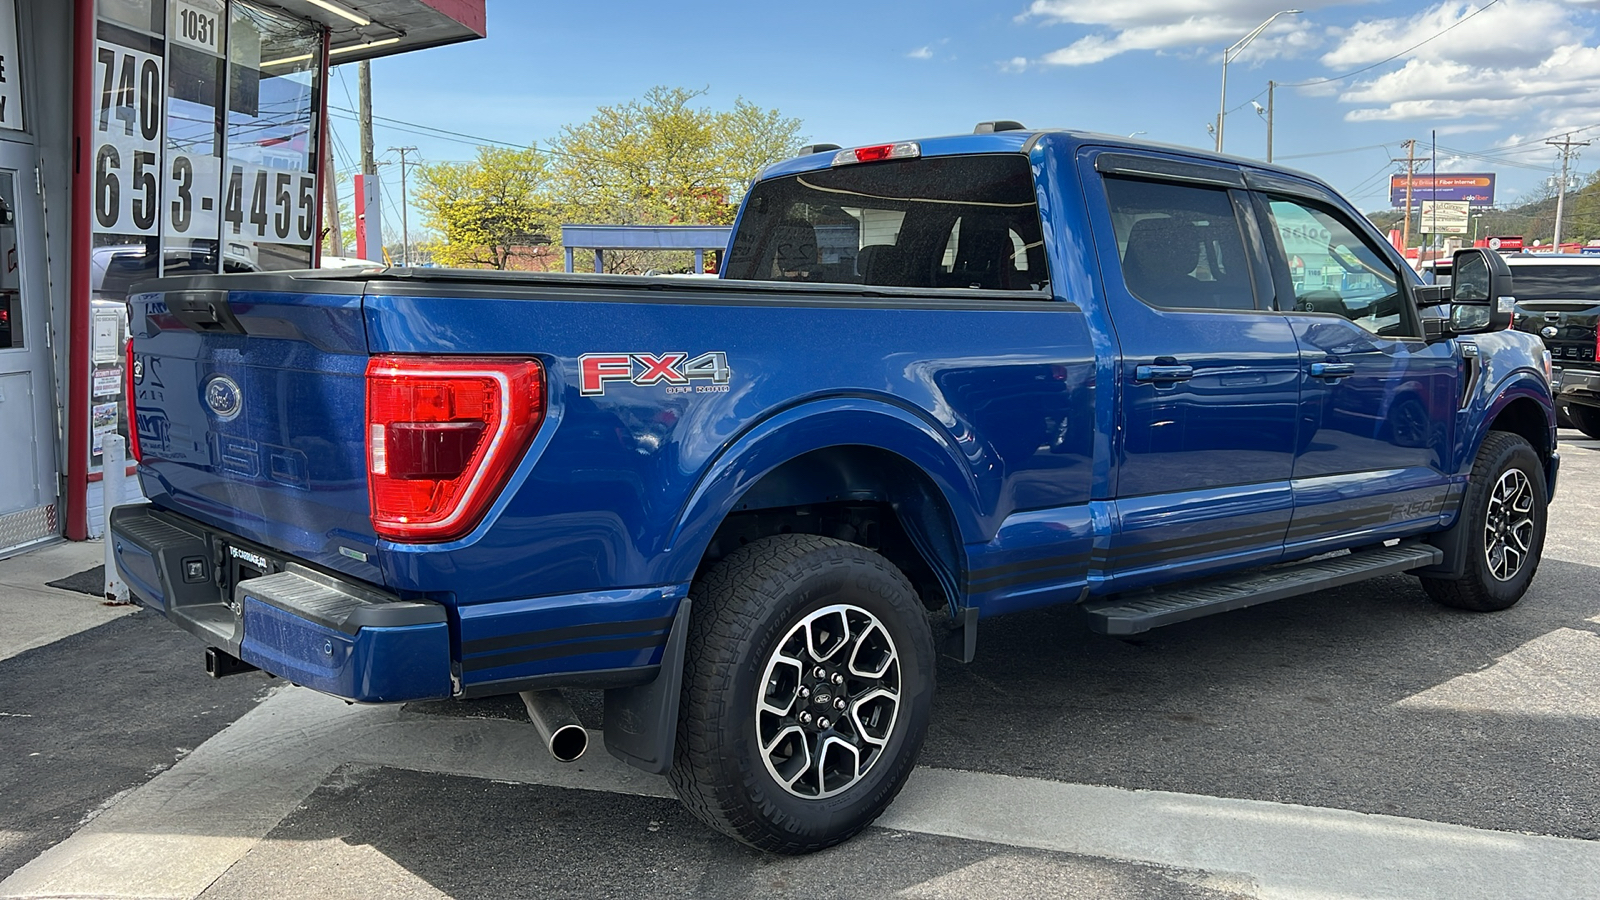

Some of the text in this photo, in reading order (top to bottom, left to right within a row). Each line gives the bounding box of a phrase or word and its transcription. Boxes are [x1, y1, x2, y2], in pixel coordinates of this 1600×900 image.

[180, 8, 214, 46] 1031
[97, 46, 160, 141] 740
[578, 351, 730, 397] FX4
[208, 385, 230, 408] Ford
[665, 385, 730, 394] OFF ROAD
[1390, 499, 1433, 519] F-150
[748, 590, 811, 673] TERRITORY AT
[815, 694, 831, 703] Ford
